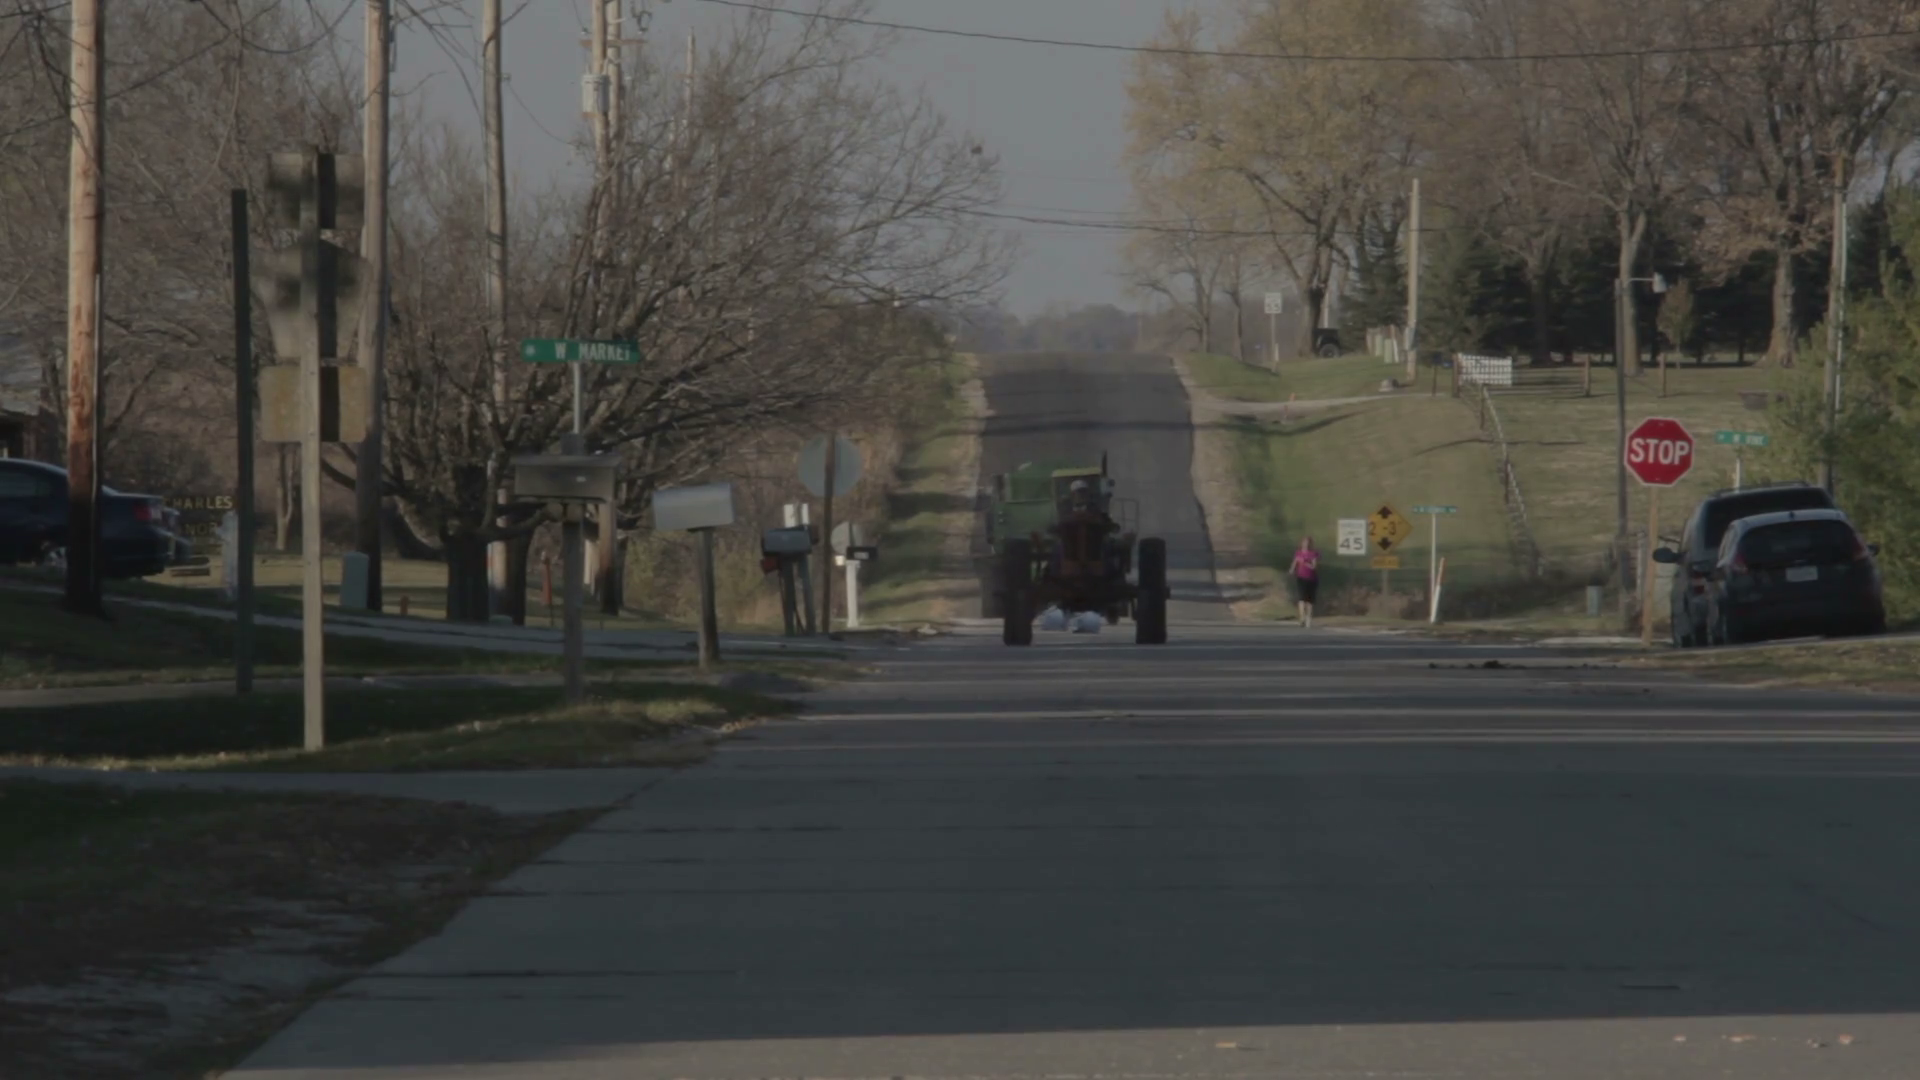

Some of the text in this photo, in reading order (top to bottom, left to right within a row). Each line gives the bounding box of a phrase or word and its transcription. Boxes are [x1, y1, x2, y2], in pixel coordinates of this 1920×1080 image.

[554, 342, 631, 360] W MARKET
[1629, 437, 1690, 466] STOP
[1339, 537, 1364, 550] 45
